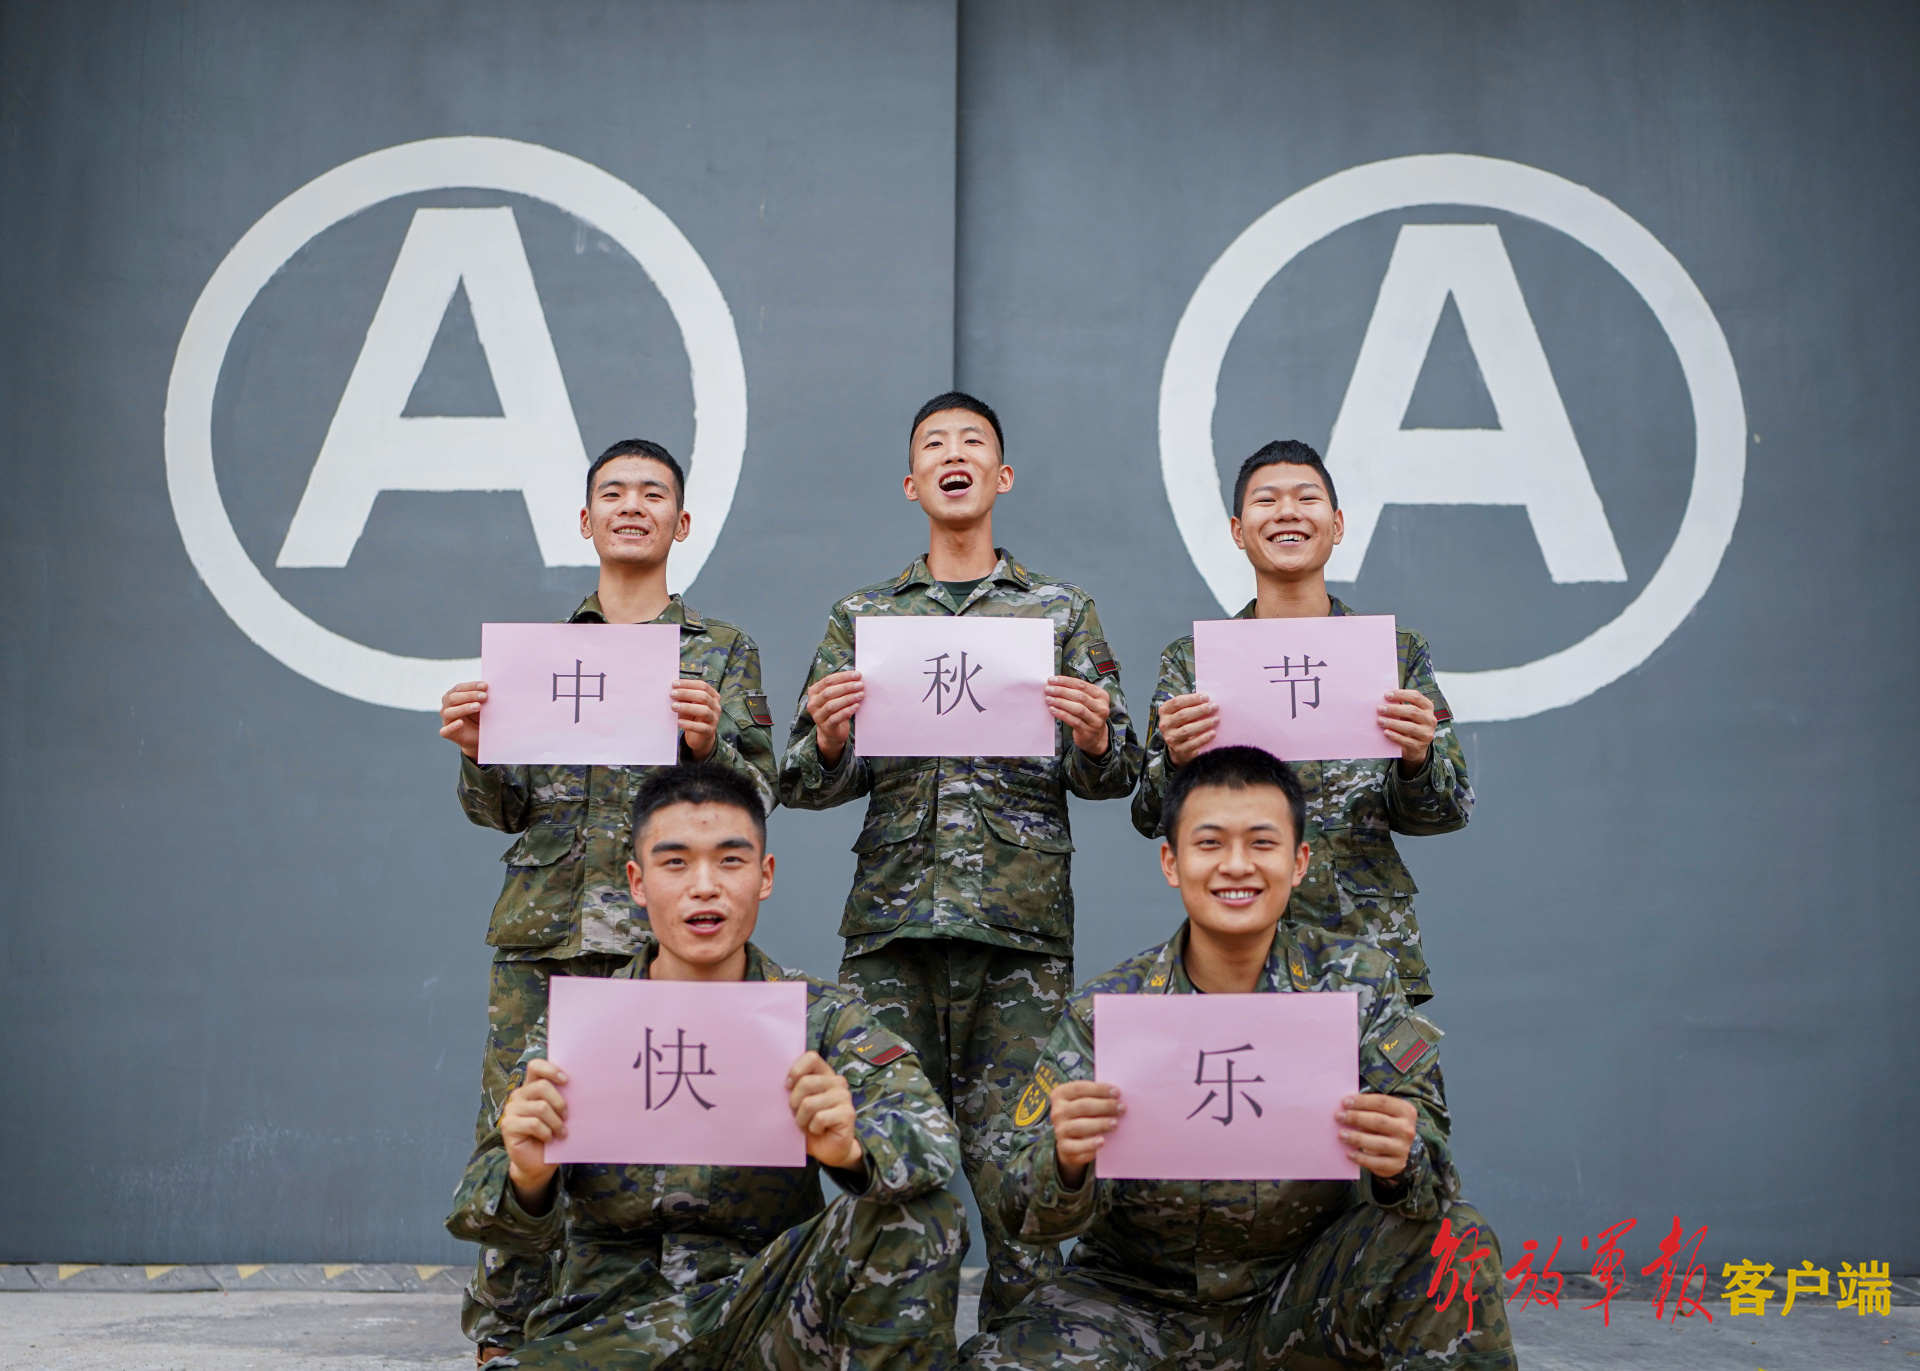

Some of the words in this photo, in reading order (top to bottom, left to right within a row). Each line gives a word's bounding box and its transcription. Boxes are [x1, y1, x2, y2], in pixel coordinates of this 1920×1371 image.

[276, 206, 600, 568] A
[1326, 223, 1627, 584] A
[552, 659, 607, 724] 中
[922, 651, 987, 716] 秋
[1263, 654, 1328, 720] 节
[632, 1027, 717, 1111] 快
[1186, 1043, 1265, 1127] 乐
